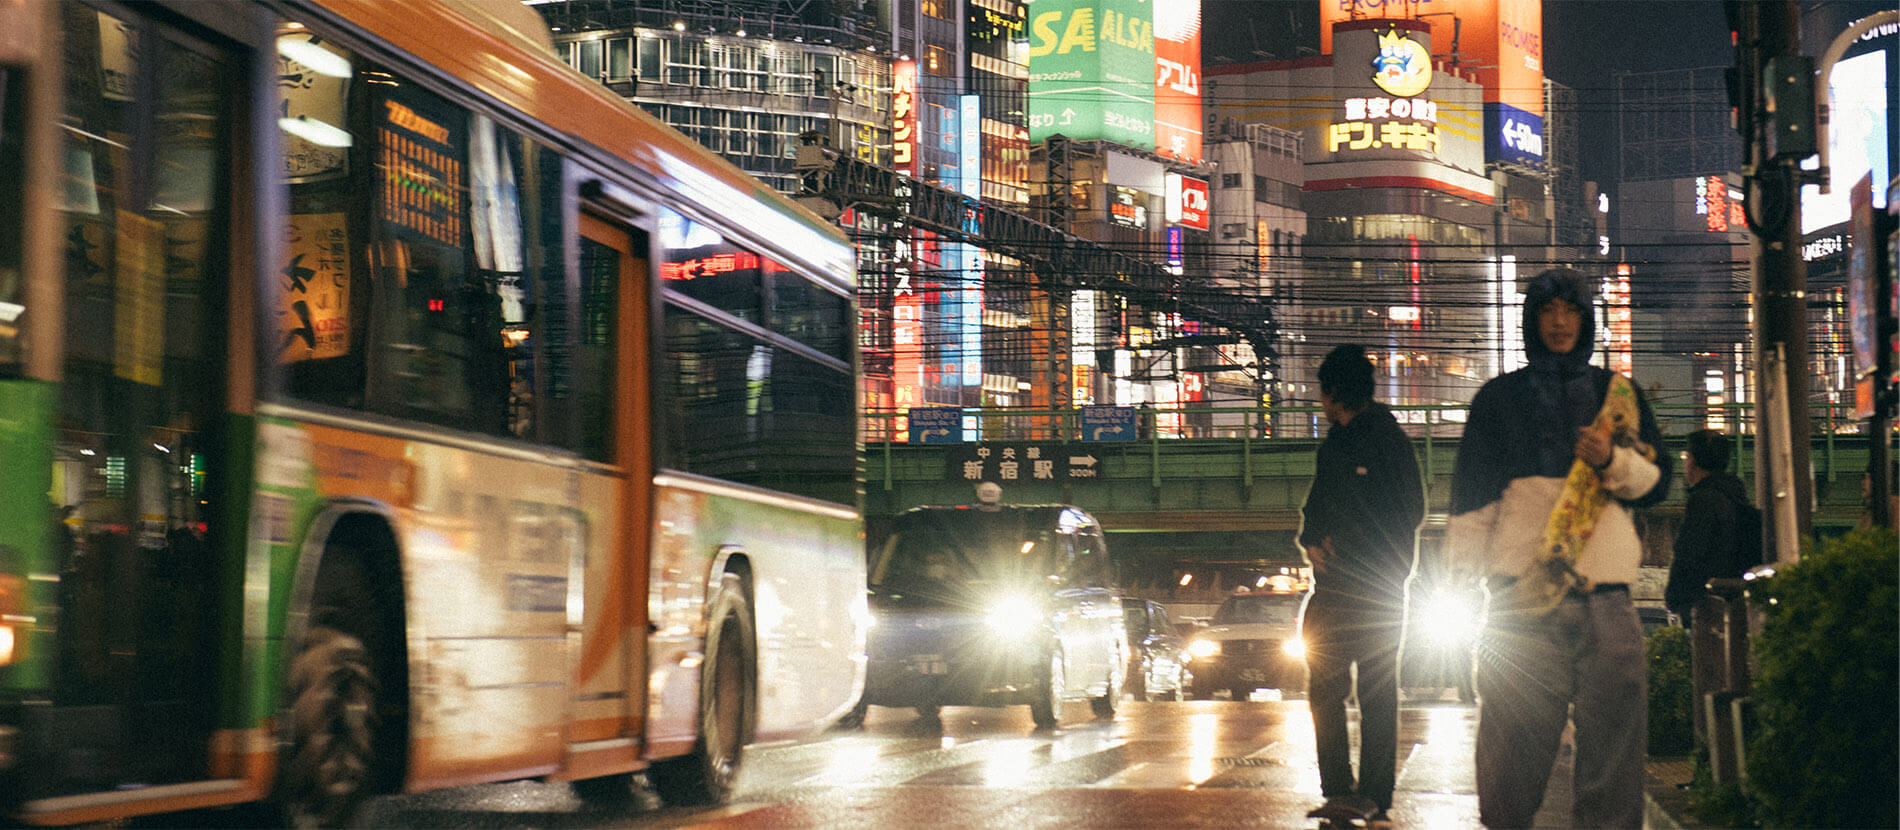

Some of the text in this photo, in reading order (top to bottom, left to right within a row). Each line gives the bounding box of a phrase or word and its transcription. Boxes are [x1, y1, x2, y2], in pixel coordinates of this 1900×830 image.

[1101, 9, 1152, 54] ALSA
[1156, 57, 1199, 96] アコム
[893, 73, 911, 163] パチンコ
[963, 460, 1053, 480] 新宿駅
[977, 447, 1041, 460] 中央線
